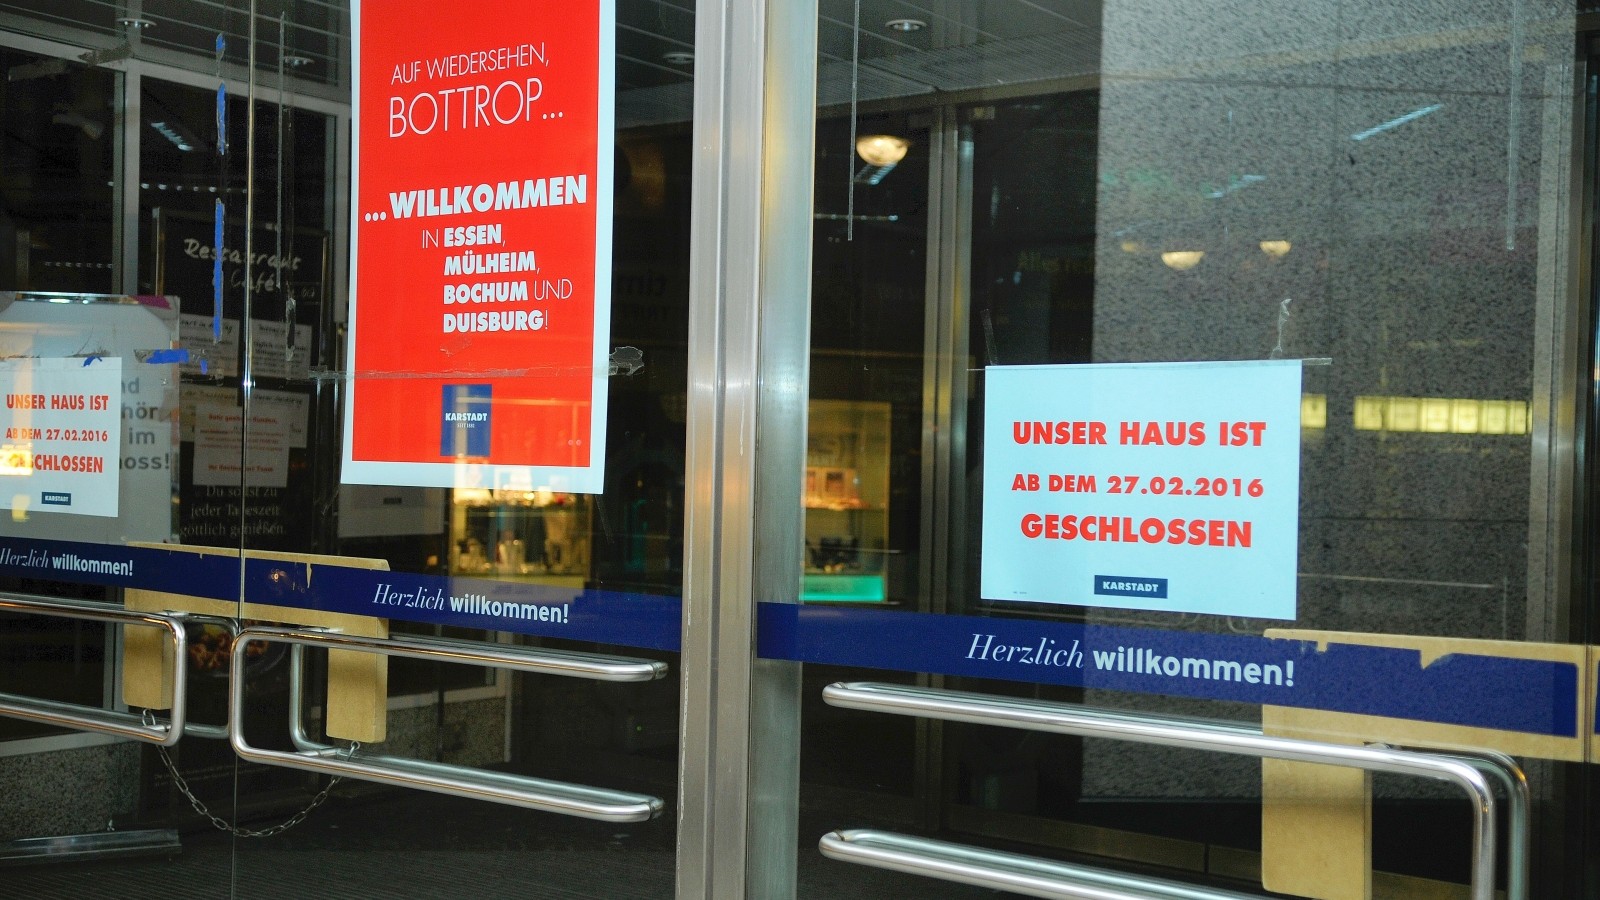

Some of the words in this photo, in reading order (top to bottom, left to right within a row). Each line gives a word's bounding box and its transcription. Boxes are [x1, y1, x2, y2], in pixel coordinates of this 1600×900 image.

[391, 61, 422, 85] AUF
[426, 42, 549, 80] WIEDERSEHEN,
[389, 78, 563, 138] BOTTROP...
[421, 229, 439, 249] IN
[444, 223, 506, 248] ESSEN,
[183, 238, 302, 270] Restarant
[443, 250, 540, 276] MÜLHEIM,
[231, 268, 275, 292] Cfé
[443, 281, 528, 305] BOCHUM
[534, 279, 573, 301] UND
[443, 310, 548, 333] DUISBURG!
[6, 394, 46, 410] UNSER
[51, 395, 85, 410] HAUS
[90, 395, 109, 411] IST
[445, 412, 488, 422] KARSTADT
[6, 427, 19, 439] AB
[21, 428, 42, 440] DEM
[46, 429, 108, 442] 27.02.2016
[128, 427, 155, 444] im
[1013, 421, 1108, 446] UNSER
[1119, 421, 1207, 447] HAUS
[1219, 421, 1267, 447] IST
[8, 453, 104, 473] CHLOSSEN
[1011, 473, 1040, 491] AB
[1048, 475, 1097, 493] DEM
[1107, 476, 1264, 497] 27.02.2016
[227, 504, 281, 517] Taeszeit
[1021, 513, 1252, 548] GESCHLOSSEN
[0, 547, 49, 569] Herzlich
[52, 553, 133, 577] willkommen!
[1102, 580, 1159, 593] KARSTADT
[372, 583, 445, 611] Herzlich
[450, 593, 570, 624] willkommen!
[964, 633, 1084, 669] Herzlich
[1093, 645, 1294, 688] willkommen!
